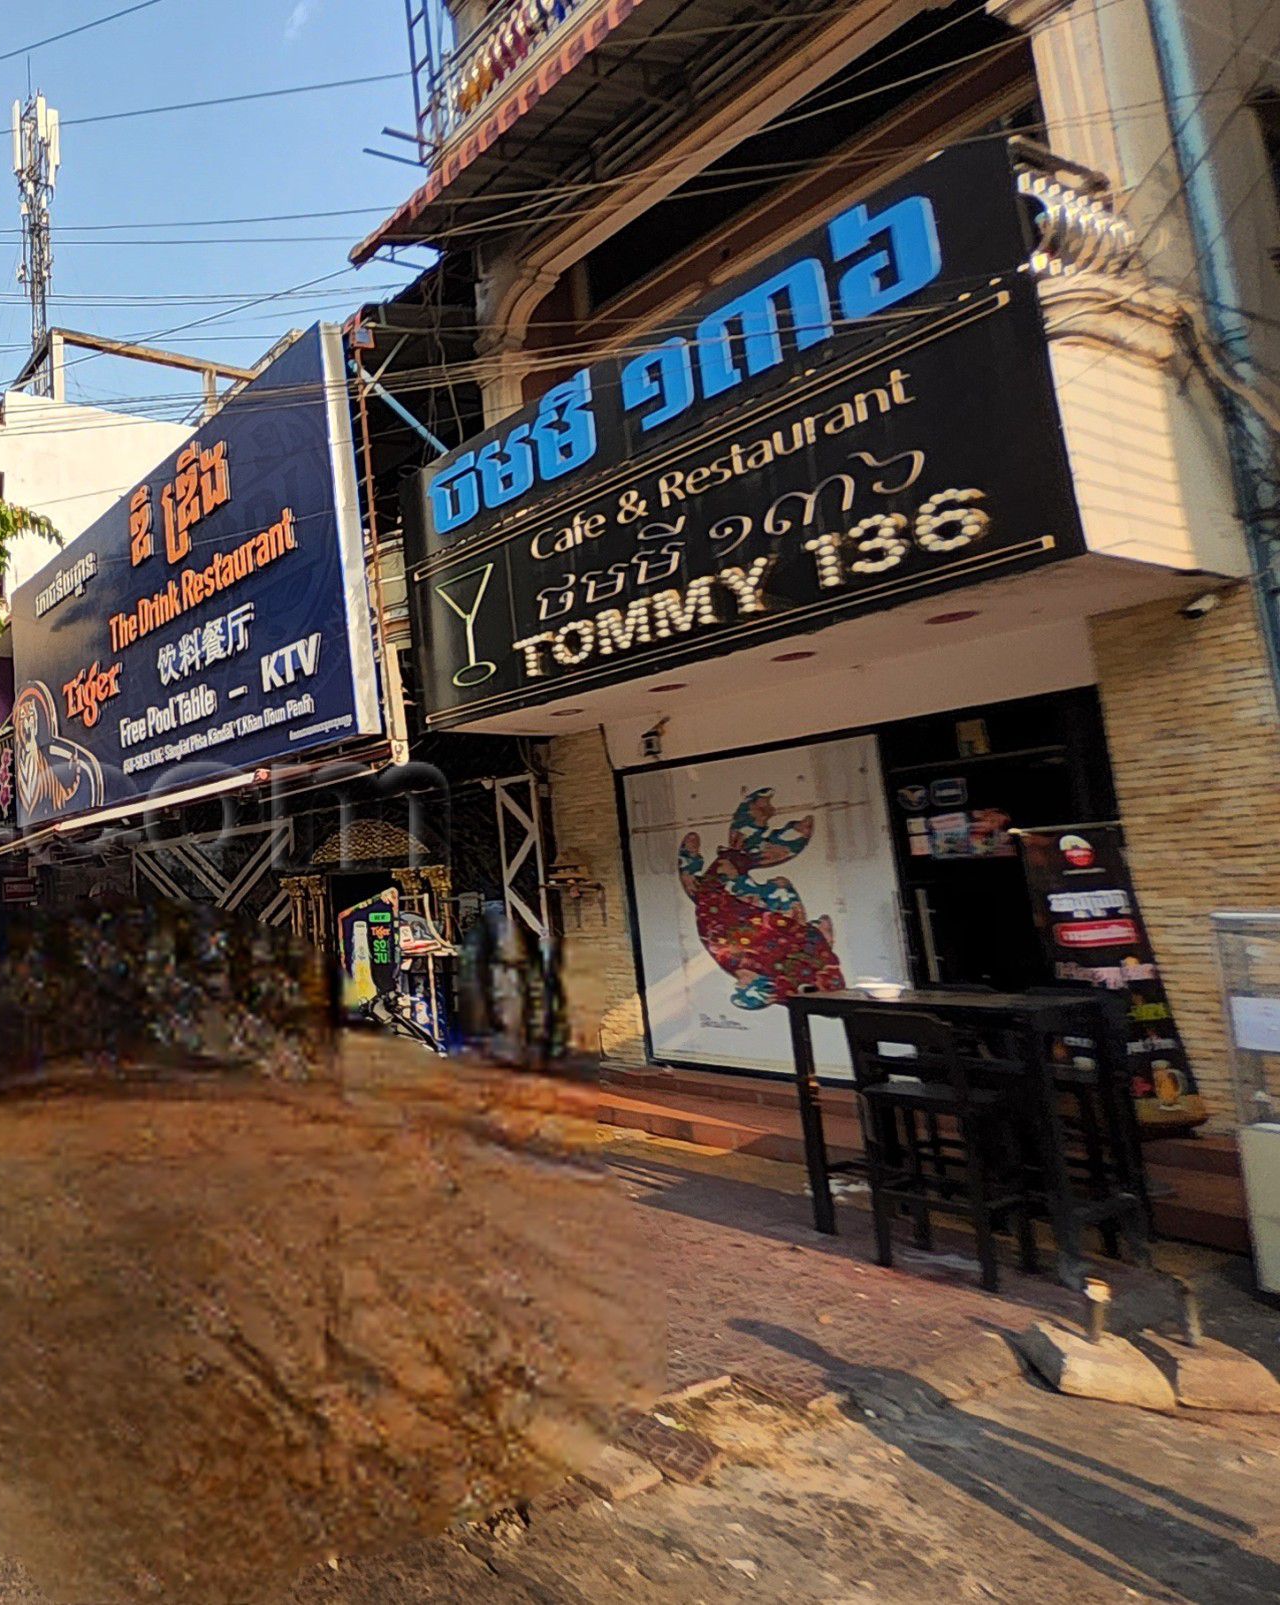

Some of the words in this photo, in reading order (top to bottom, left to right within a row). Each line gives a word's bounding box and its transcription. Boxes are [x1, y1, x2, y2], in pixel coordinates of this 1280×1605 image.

[532, 508, 606, 560] Cafe
[616, 489, 648, 525] &
[657, 368, 919, 508] Restaurant
[109, 610, 139, 653] The
[138, 579, 182, 638] Drink
[182, 507, 299, 611] Restaurant
[513, 553, 770, 678] TOMMY
[806, 487, 990, 588] 136
[62, 659, 122, 728] Tiger
[120, 714, 147, 749] Free
[147, 697, 177, 738] Pool
[177, 682, 217, 726] Table
[261, 632, 323, 694] KTV
[157, 602, 255, 686] 饮料餐厅
[373, 939, 387, 952] SO
